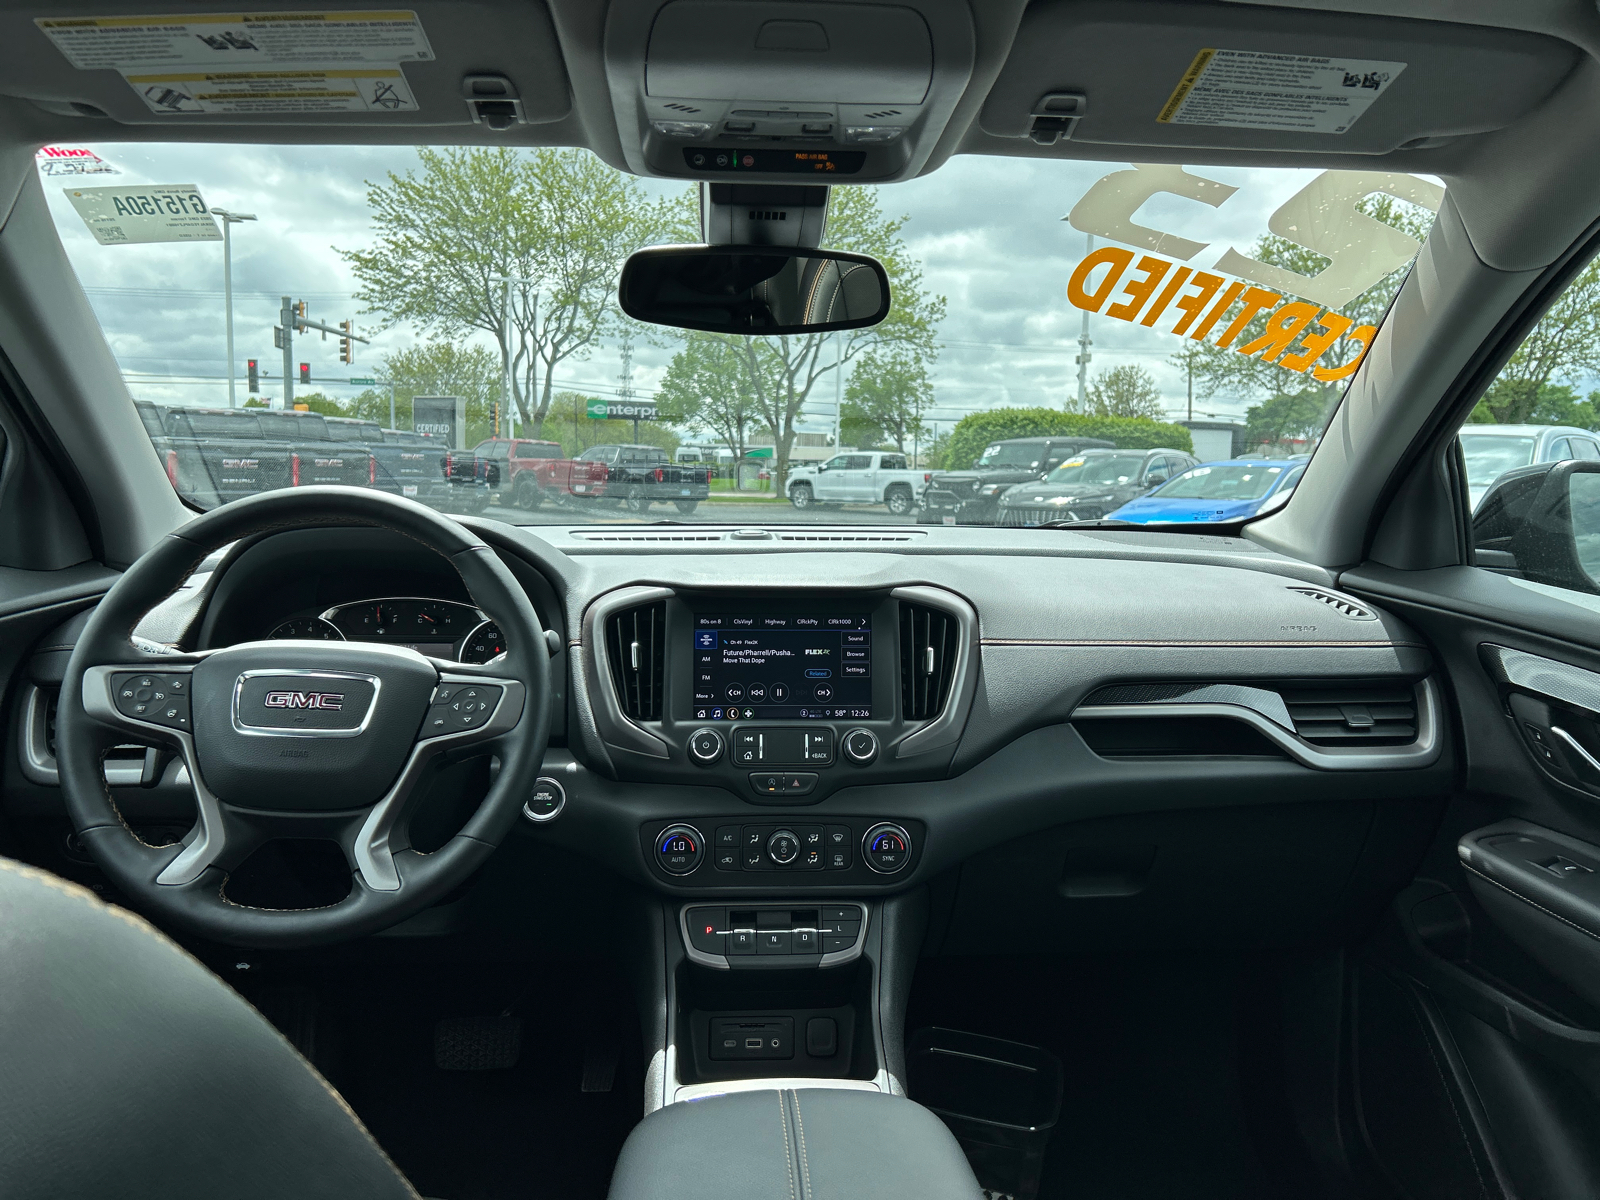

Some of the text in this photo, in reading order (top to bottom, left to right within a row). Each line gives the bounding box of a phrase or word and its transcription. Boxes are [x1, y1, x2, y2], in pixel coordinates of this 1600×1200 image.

[587, 404, 659, 418] enterpr
[416, 424, 450, 434] CERTIFIED
[845, 666, 866, 674] Settings
[265, 691, 344, 710] GMC
[851, 709, 870, 717] 12:26
[280, 750, 309, 758] AIRBAG
[673, 841, 685, 851] LO
[882, 840, 894, 850] 61
[706, 926, 712, 934] P
[740, 934, 746, 942] R
